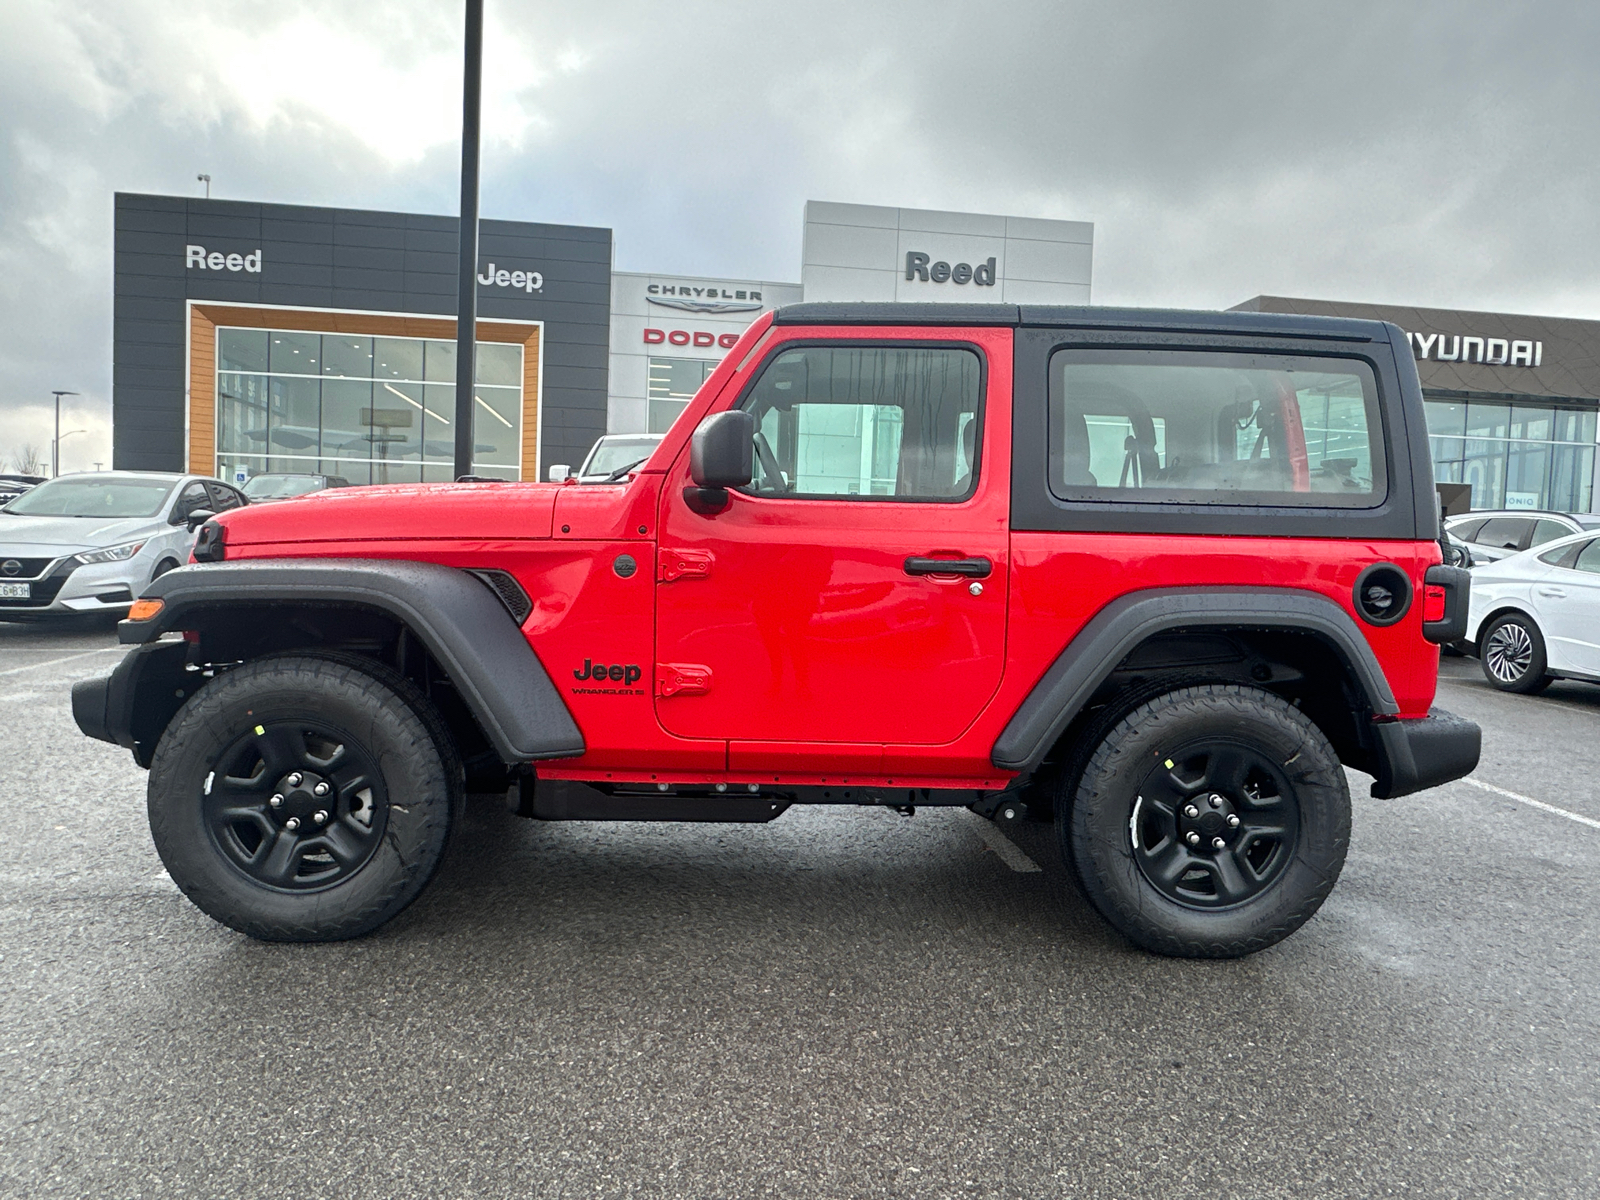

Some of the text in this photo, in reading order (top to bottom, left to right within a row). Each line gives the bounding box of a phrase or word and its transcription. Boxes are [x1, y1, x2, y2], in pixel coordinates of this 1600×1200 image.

[186, 244, 262, 273] Reed
[905, 251, 996, 287] Reed
[477, 262, 544, 293] Jeep
[647, 284, 762, 301] CHRYSLER
[643, 328, 740, 349] DODG
[573, 658, 642, 685] Jeep
